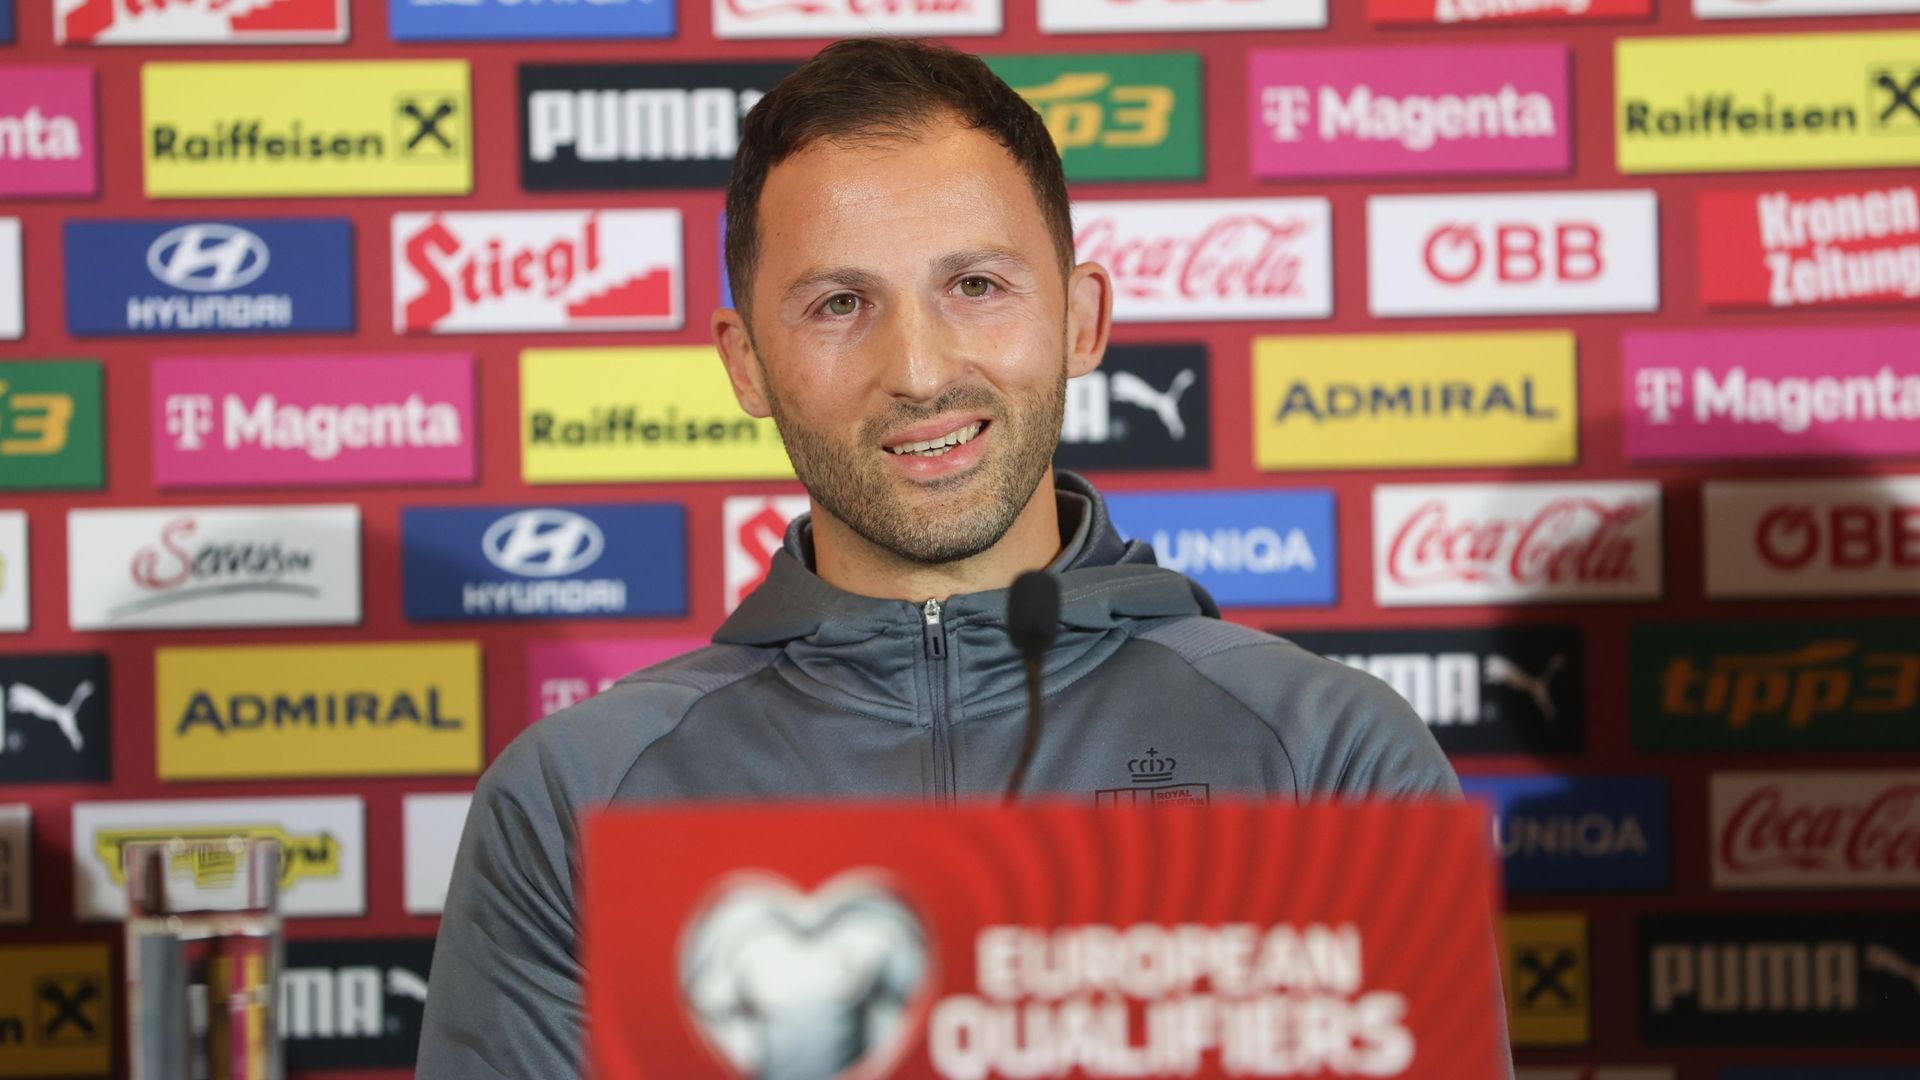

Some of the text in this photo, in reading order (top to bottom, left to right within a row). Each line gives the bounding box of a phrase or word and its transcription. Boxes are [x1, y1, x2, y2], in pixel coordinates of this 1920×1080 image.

[151, 119, 384, 163] Raiffeisen
[529, 88, 738, 162] PUMA
[1318, 83, 1556, 151] Magenta
[1625, 94, 1857, 138] Raiffeisen
[1756, 186, 1919, 249] Kronen
[403, 214, 602, 331] Stiegl
[1422, 220, 1605, 285] ÖBB
[1762, 242, 1920, 307] Zeitung
[127, 295, 291, 329] HYUNDAI
[222, 393, 461, 460] Magenta
[529, 404, 758, 448] Raiffeisen
[1274, 377, 1557, 425] ADMIRAL
[1153, 526, 1317, 574] UNIQA
[463, 580, 627, 616] HYUNDAI
[176, 684, 466, 738] ADMIRAL
[1157, 789, 1192, 800] ROYAL
[1494, 812, 1648, 857] UNIQA
[977, 922, 1364, 1000] EUROPEAN
[1651, 944, 1859, 1012] PUMA
[928, 991, 1416, 1080] QUALIFIERS
